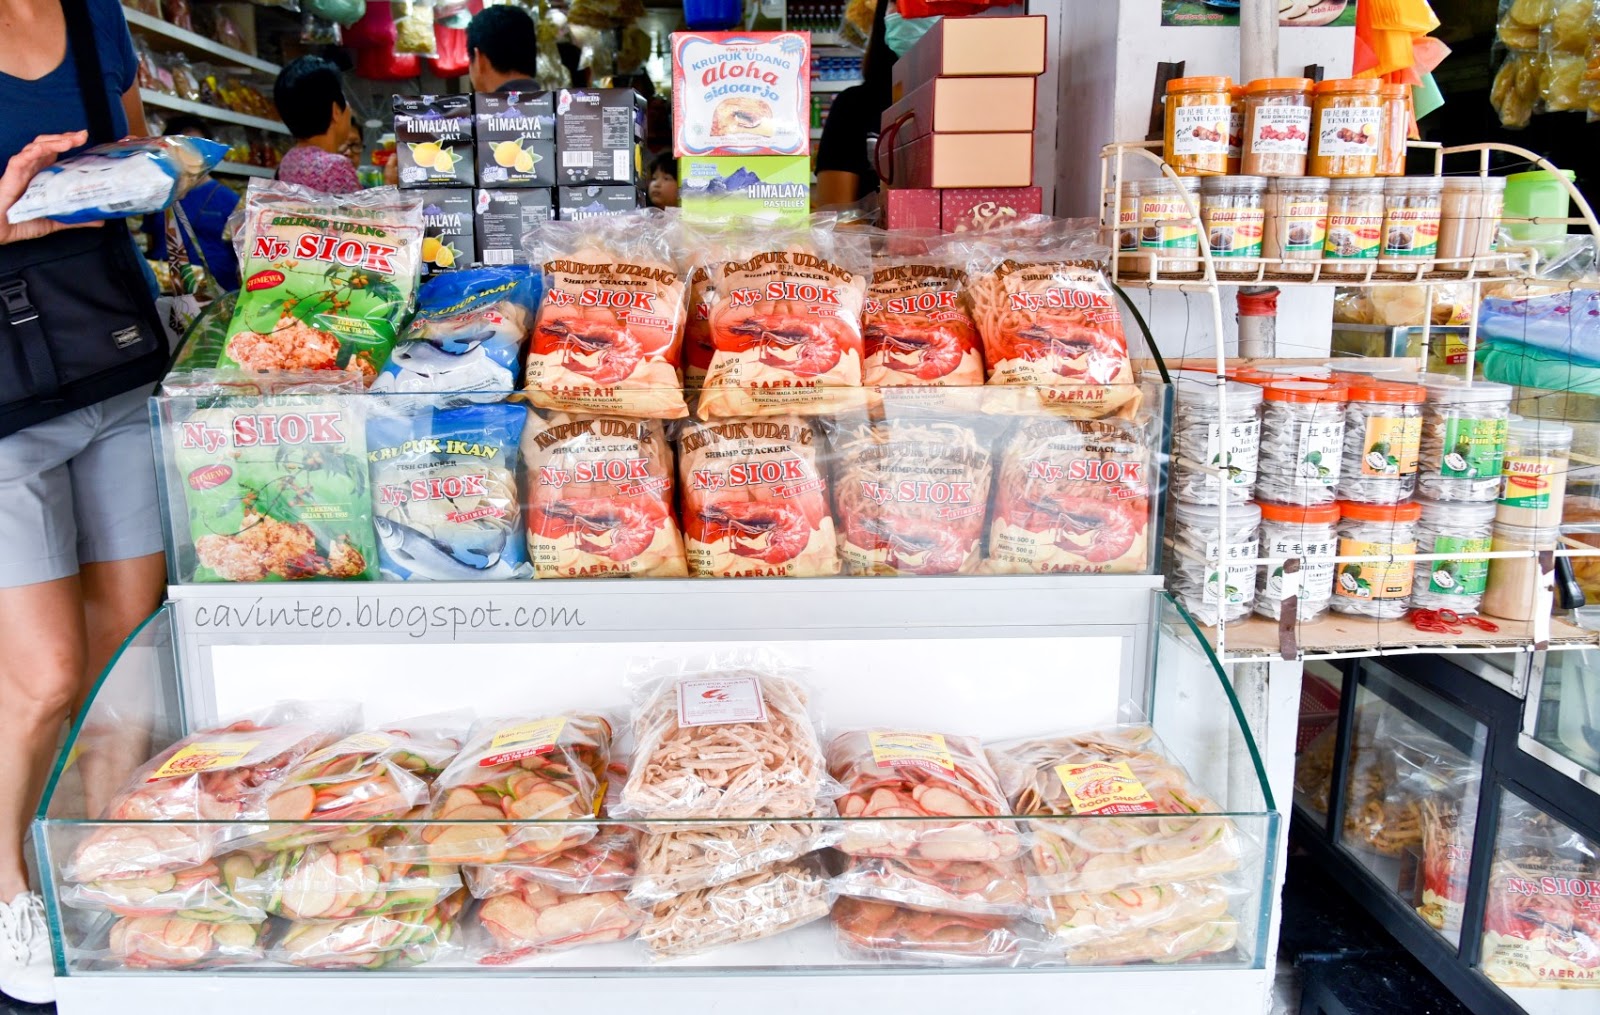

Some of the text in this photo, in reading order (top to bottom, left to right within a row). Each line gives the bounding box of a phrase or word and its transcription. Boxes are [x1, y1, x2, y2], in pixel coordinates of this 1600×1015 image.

[692, 52, 791, 72] KRUPUK UDANG
[702, 61, 779, 87] aloha
[703, 83, 780, 103] sidoarjo
[407, 119, 460, 133] HIMALAYA
[488, 118, 541, 131] HIMALAYA
[521, 131, 541, 139] SALT
[748, 184, 805, 198] HIMALAYA
[763, 200, 805, 208] PASTILLES
[1144, 203, 1168, 213] GOOD
[1290, 206, 1315, 215] GOOD
[1120, 212, 1136, 222] GOO
[1212, 213, 1238, 222] GOOD
[1331, 215, 1358, 225] GOOD
[1390, 210, 1418, 220] GOOD
[333, 221, 386, 238] UDANG
[253, 232, 398, 276] Ny. SIOK
[543, 259, 677, 286] KRUPUK UDANG
[723, 251, 853, 283] KRUPUK UDANG
[563, 277, 648, 287] SHRIMP CRACKERS
[744, 270, 830, 281] SHRIMP CRACKERS
[911, 264, 969, 287] UDANG
[900, 281, 948, 293] CRACKERS
[545, 288, 656, 314] Ny. SIOK
[730, 288, 762, 308] Ny.
[766, 281, 842, 305] SIOK
[1009, 287, 1112, 312] Ny. SIOK
[888, 291, 957, 314] SIOK
[551, 385, 614, 397] SAERAH
[1048, 389, 1104, 400] SAERAH
[182, 412, 345, 453] Ny. SIOK
[533, 419, 597, 451] KRUPUK
[682, 422, 814, 454] KRUPUK UDANG
[368, 439, 499, 463] KRUPUK IKAN
[705, 445, 792, 459] SHRIMP CRACKERS
[417, 460, 457, 469] CRACKER
[876, 465, 964, 475] SHRIMP CRACKERS
[1029, 459, 1141, 482] Ny. SIOK
[1513, 462, 1549, 473] SNACK
[540, 458, 650, 488] Ny. SIOK
[693, 459, 806, 491] Ny. SIOK
[380, 474, 489, 507] Ny. SIOK
[861, 480, 972, 505] Ny. SIOK
[457, 508, 494, 522] ISTIMEWA
[569, 563, 630, 575] SAERAH
[1041, 562, 1103, 573] SAERAH
[1228, 565, 1248, 573] Daun
[1079, 793, 1148, 808] GOOD SNACK
[1507, 878, 1538, 897] Ny.
[1539, 968, 1595, 979] SAERAH
